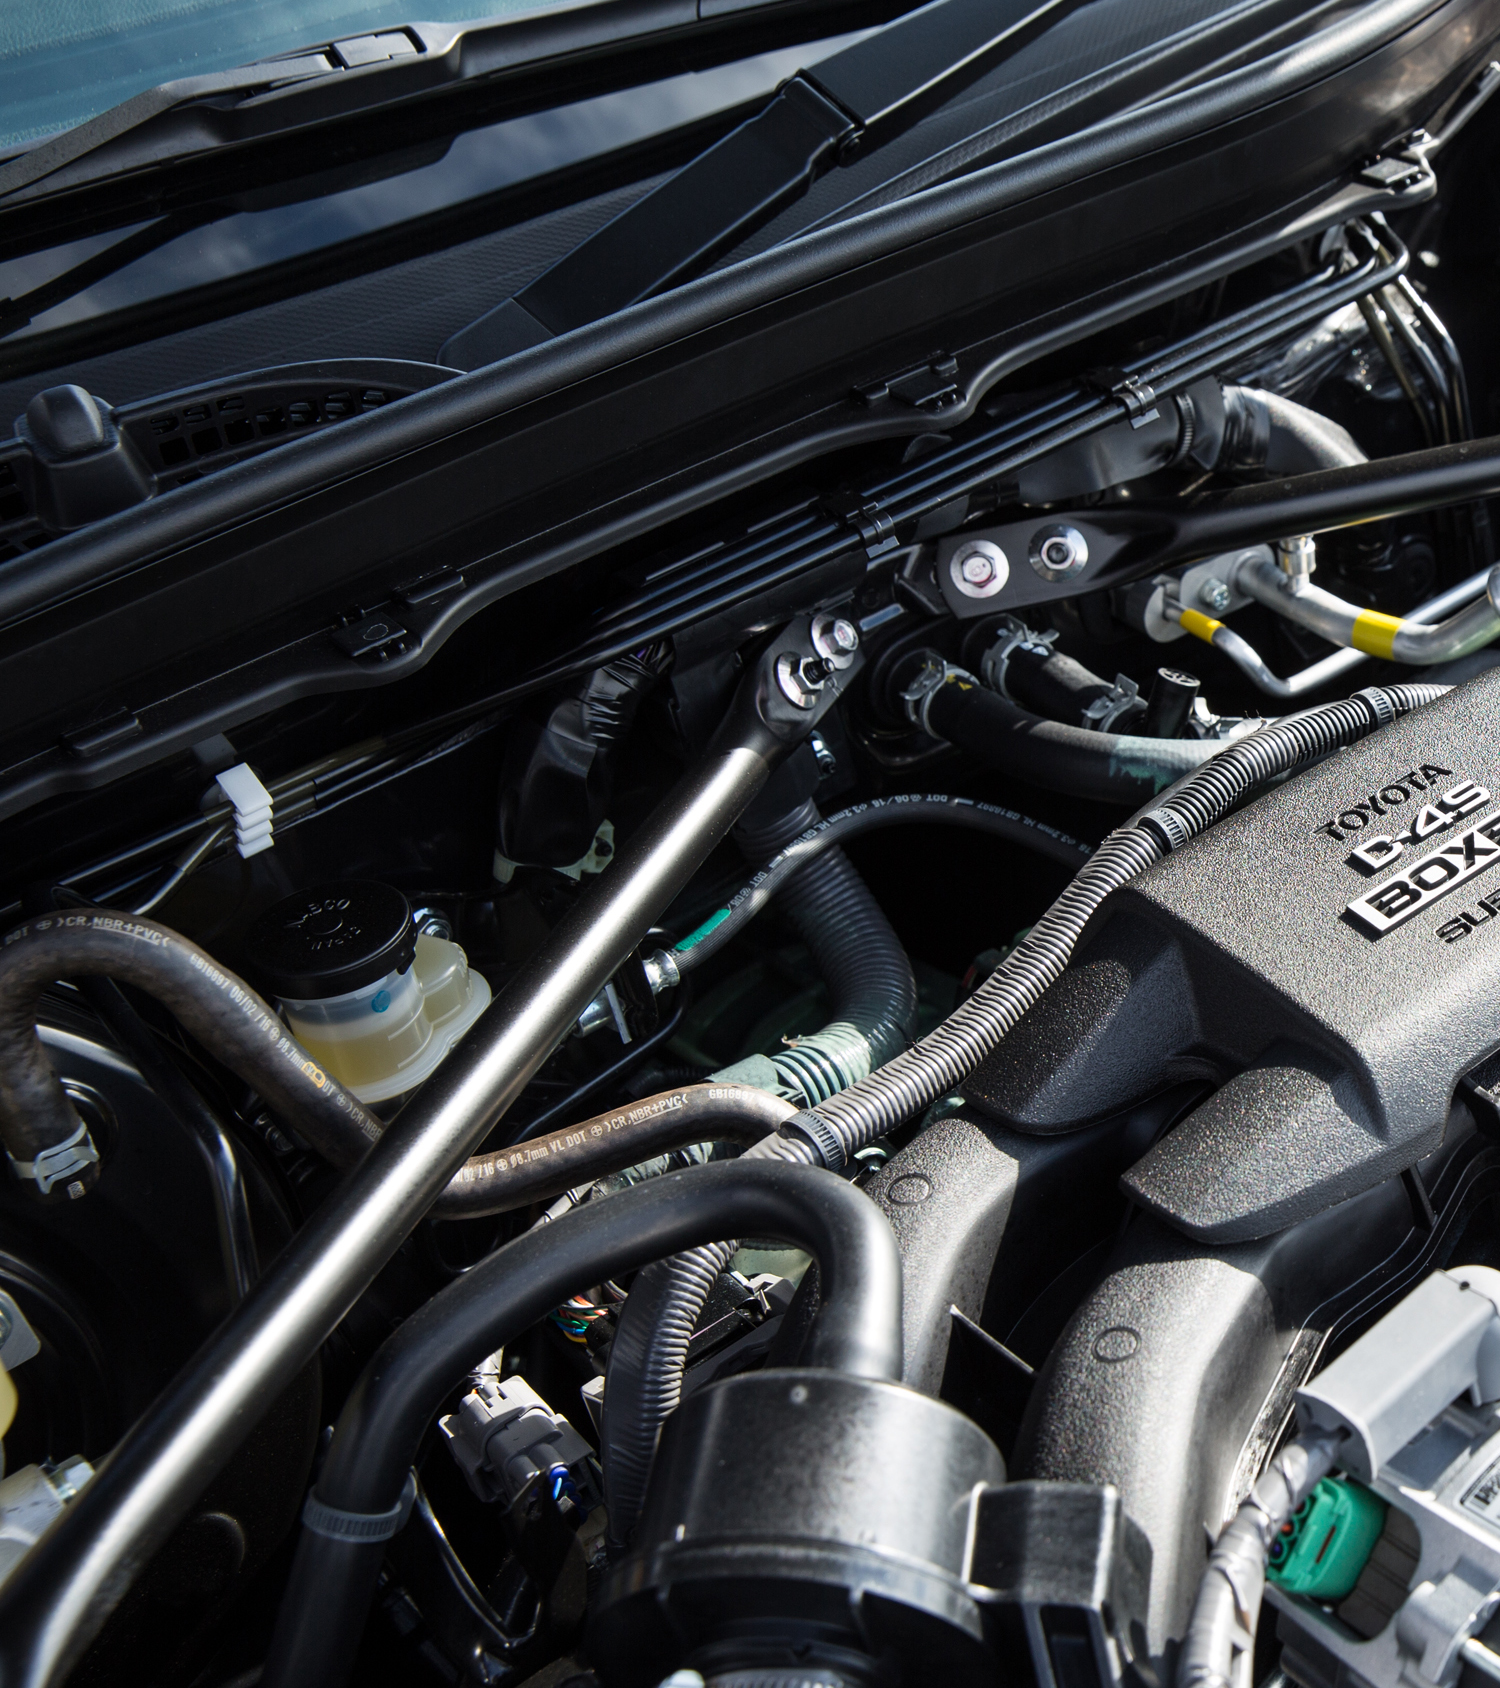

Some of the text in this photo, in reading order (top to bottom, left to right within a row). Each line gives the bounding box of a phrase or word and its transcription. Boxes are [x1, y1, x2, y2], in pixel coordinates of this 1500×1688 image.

[926, 794, 948, 803] DOT
[1313, 763, 1453, 841] TOYOTA
[750, 871, 768, 888] DOT
[5, 926, 29, 945] DOT
[189, 953, 231, 989] GB16897
[229, 985, 257, 1016] 06/02
[549, 1140, 566, 1153] VL
[566, 1130, 587, 1148] DOT
[709, 1088, 756, 1101] GB16897
